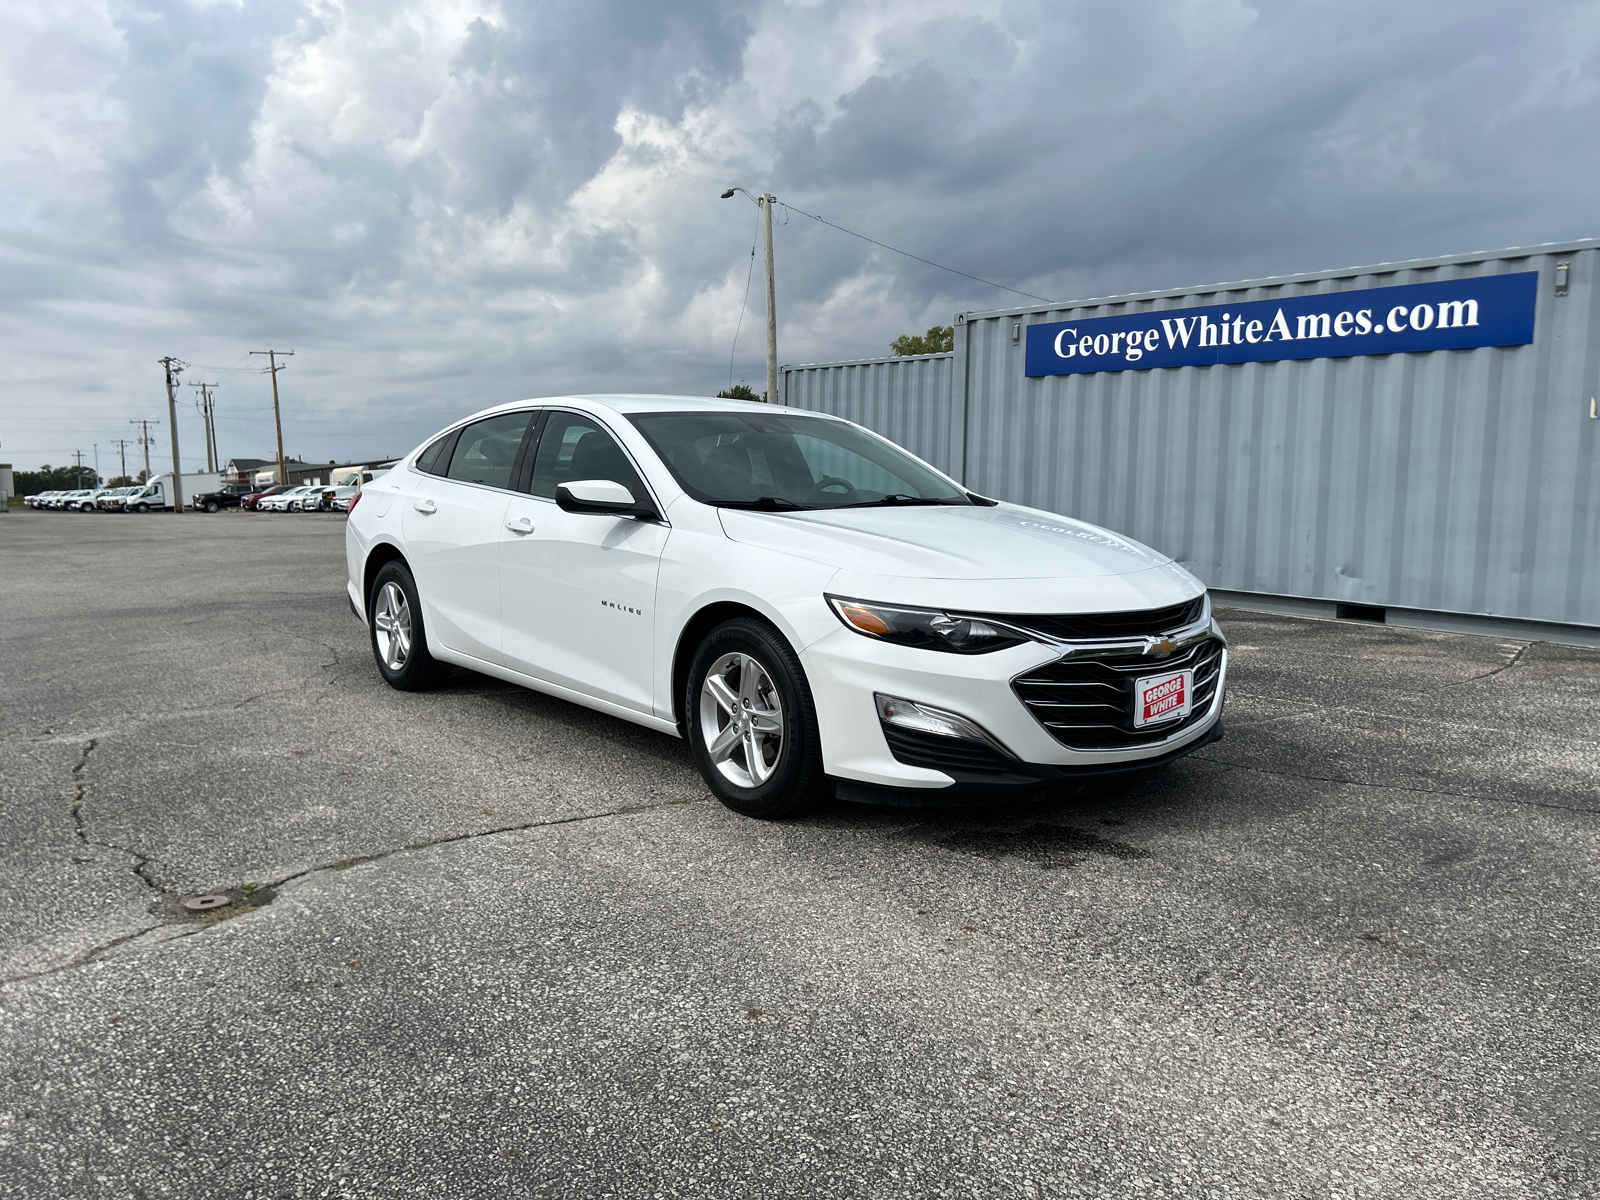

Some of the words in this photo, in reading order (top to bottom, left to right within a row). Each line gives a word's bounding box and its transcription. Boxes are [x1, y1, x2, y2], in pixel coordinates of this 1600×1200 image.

[1054, 299, 1480, 361] GeorgeWhiteAmes.com
[601, 600, 641, 615] MALIBU
[1145, 678, 1182, 703] GEORGE
[1150, 694, 1178, 716] WHITE
